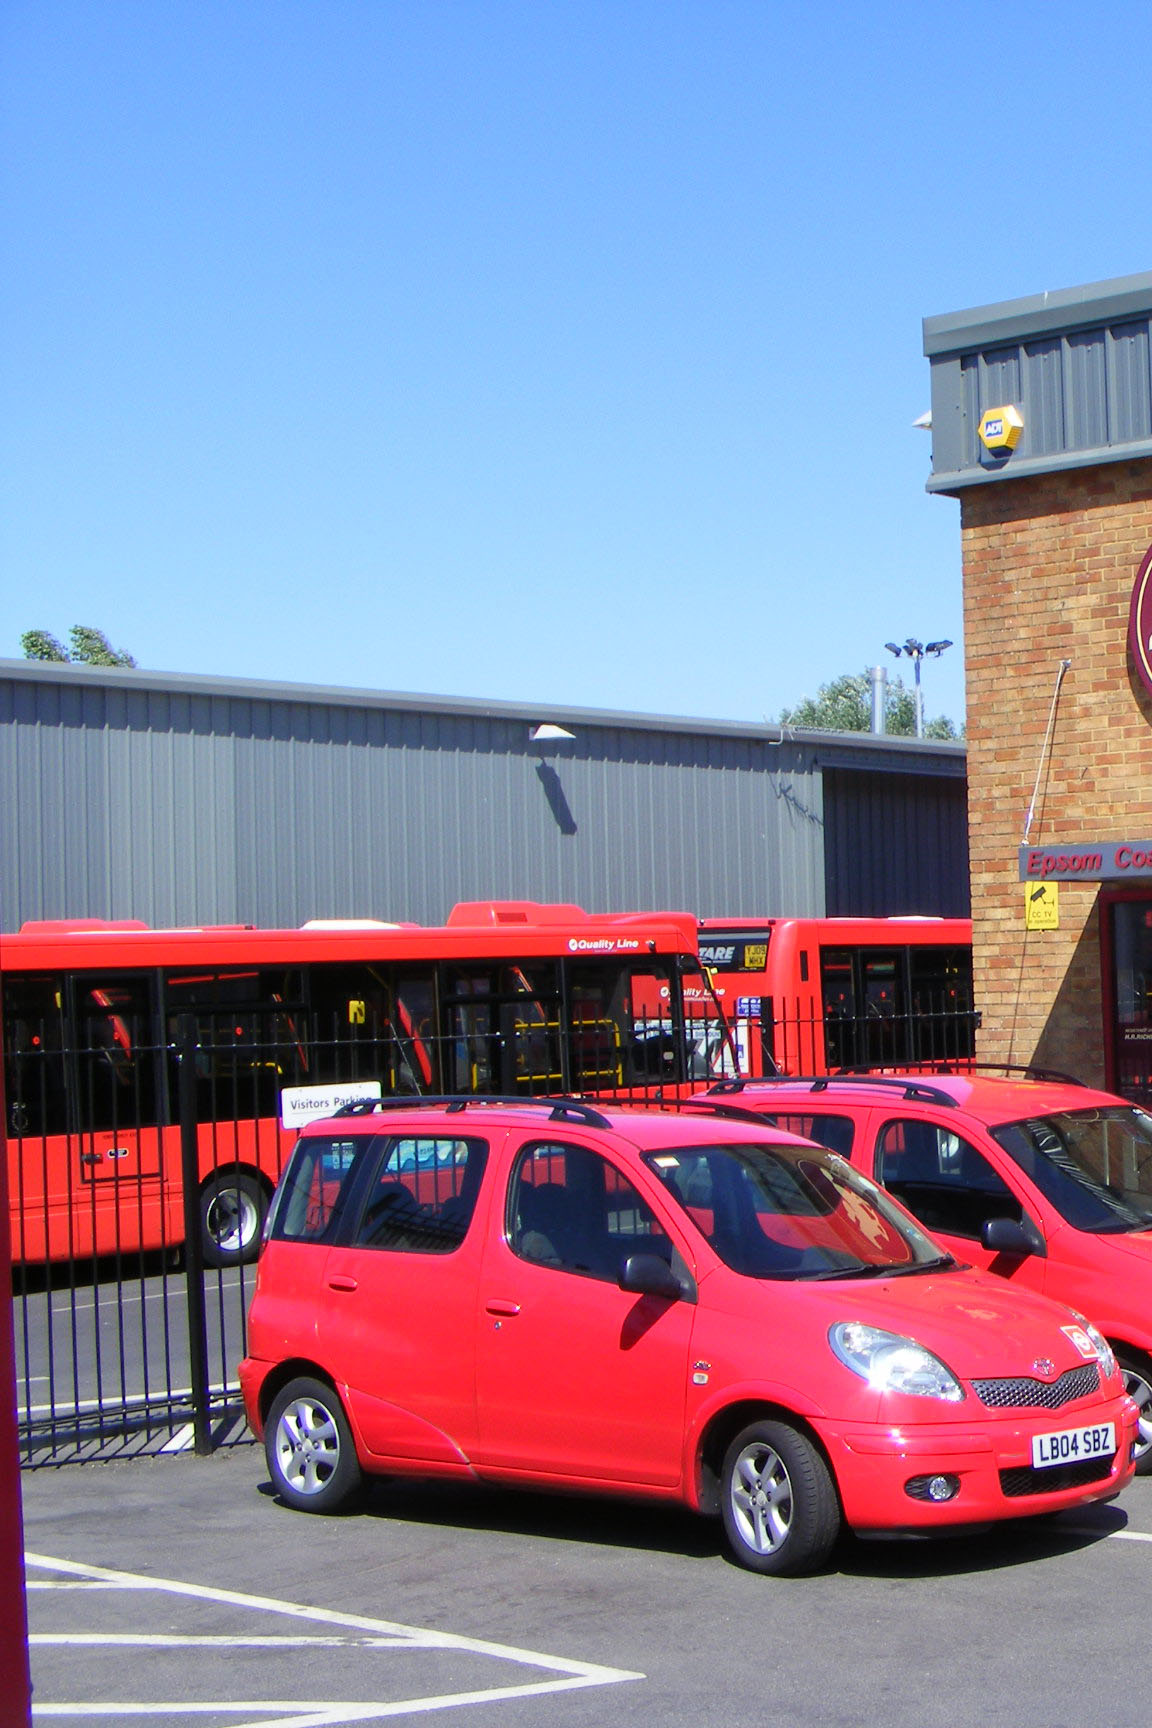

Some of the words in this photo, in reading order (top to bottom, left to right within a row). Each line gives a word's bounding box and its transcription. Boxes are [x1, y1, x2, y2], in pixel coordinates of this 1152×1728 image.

[1027, 850, 1102, 877] Epsom
[578, 939, 615, 950] Quality
[616, 938, 639, 948] Line
[290, 1098, 330, 1110] Visitors
[1039, 1433, 1079, 1462] LB04
[1083, 1427, 1110, 1454] SBZ
